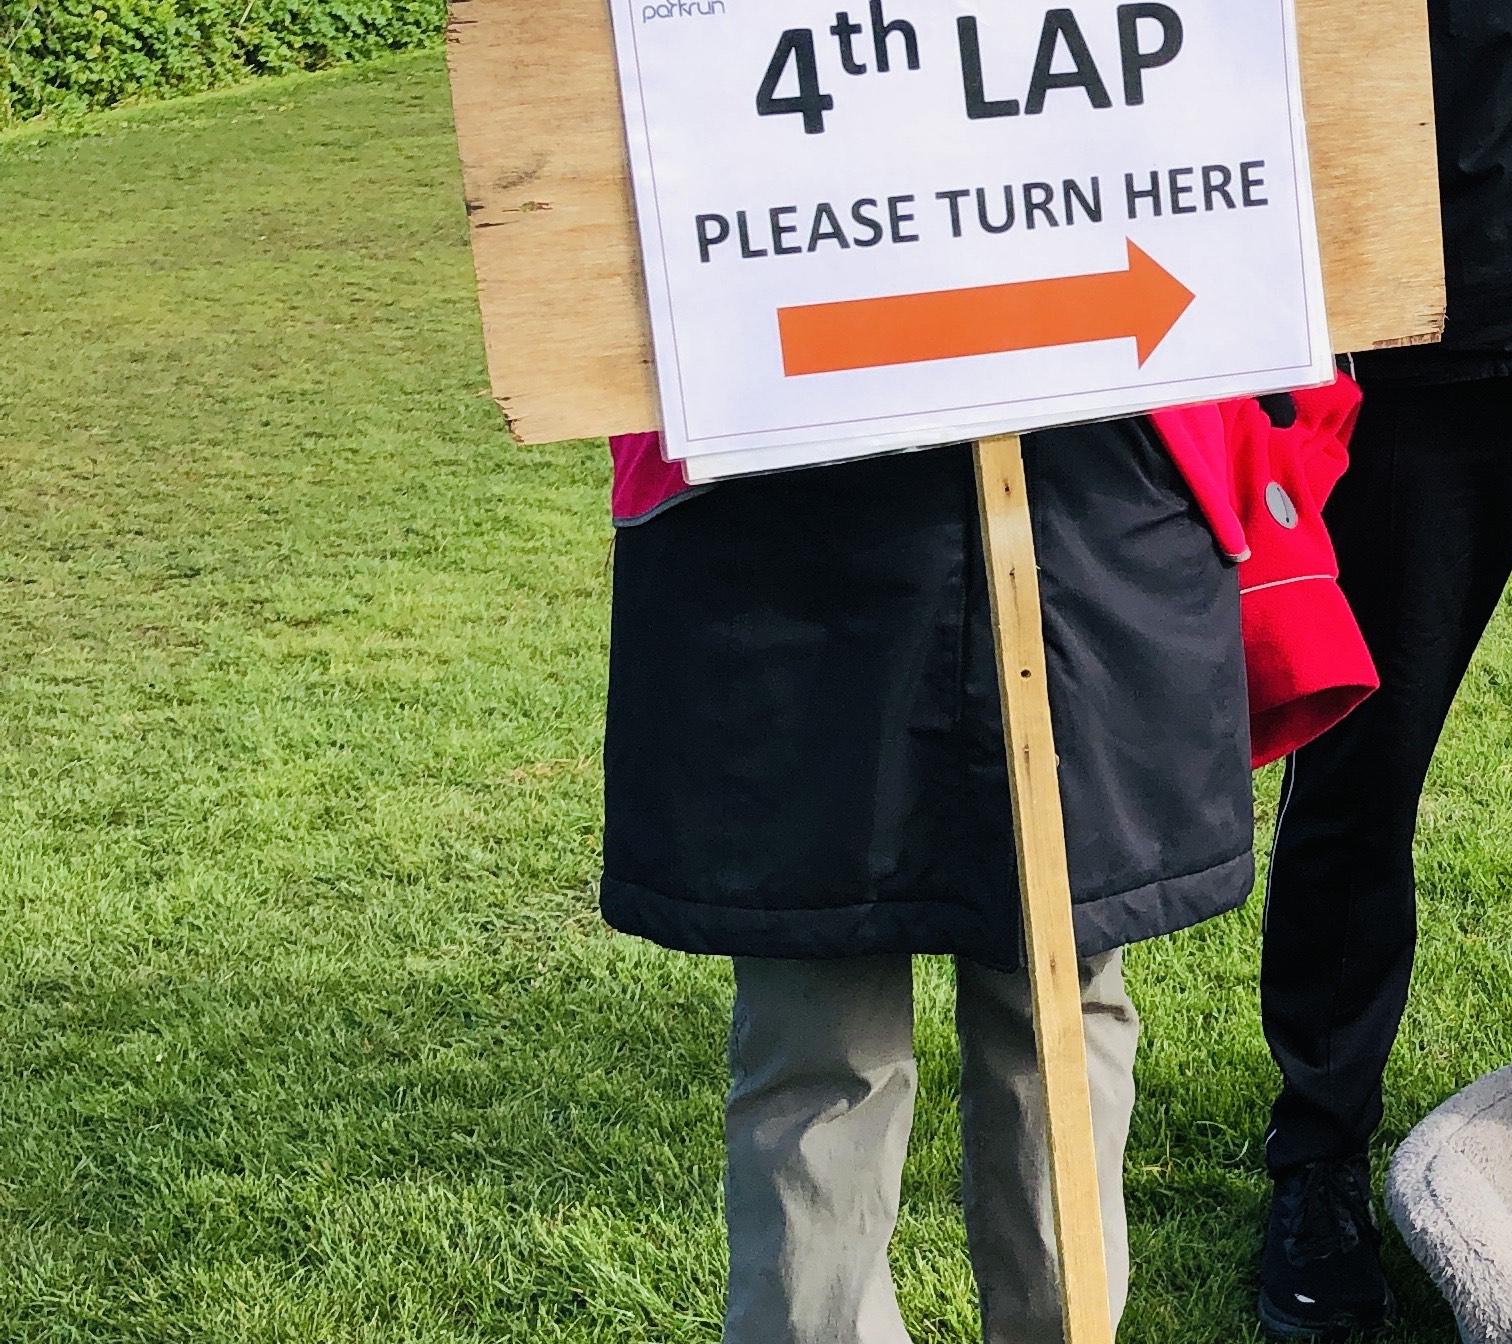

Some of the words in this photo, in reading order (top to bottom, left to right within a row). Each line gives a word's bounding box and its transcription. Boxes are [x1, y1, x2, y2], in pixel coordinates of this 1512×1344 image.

[956, 2, 1184, 120] LAP
[694, 193, 920, 263] PLEASE
[935, 175, 1102, 238] TURN
[1124, 159, 1270, 220] HERE
